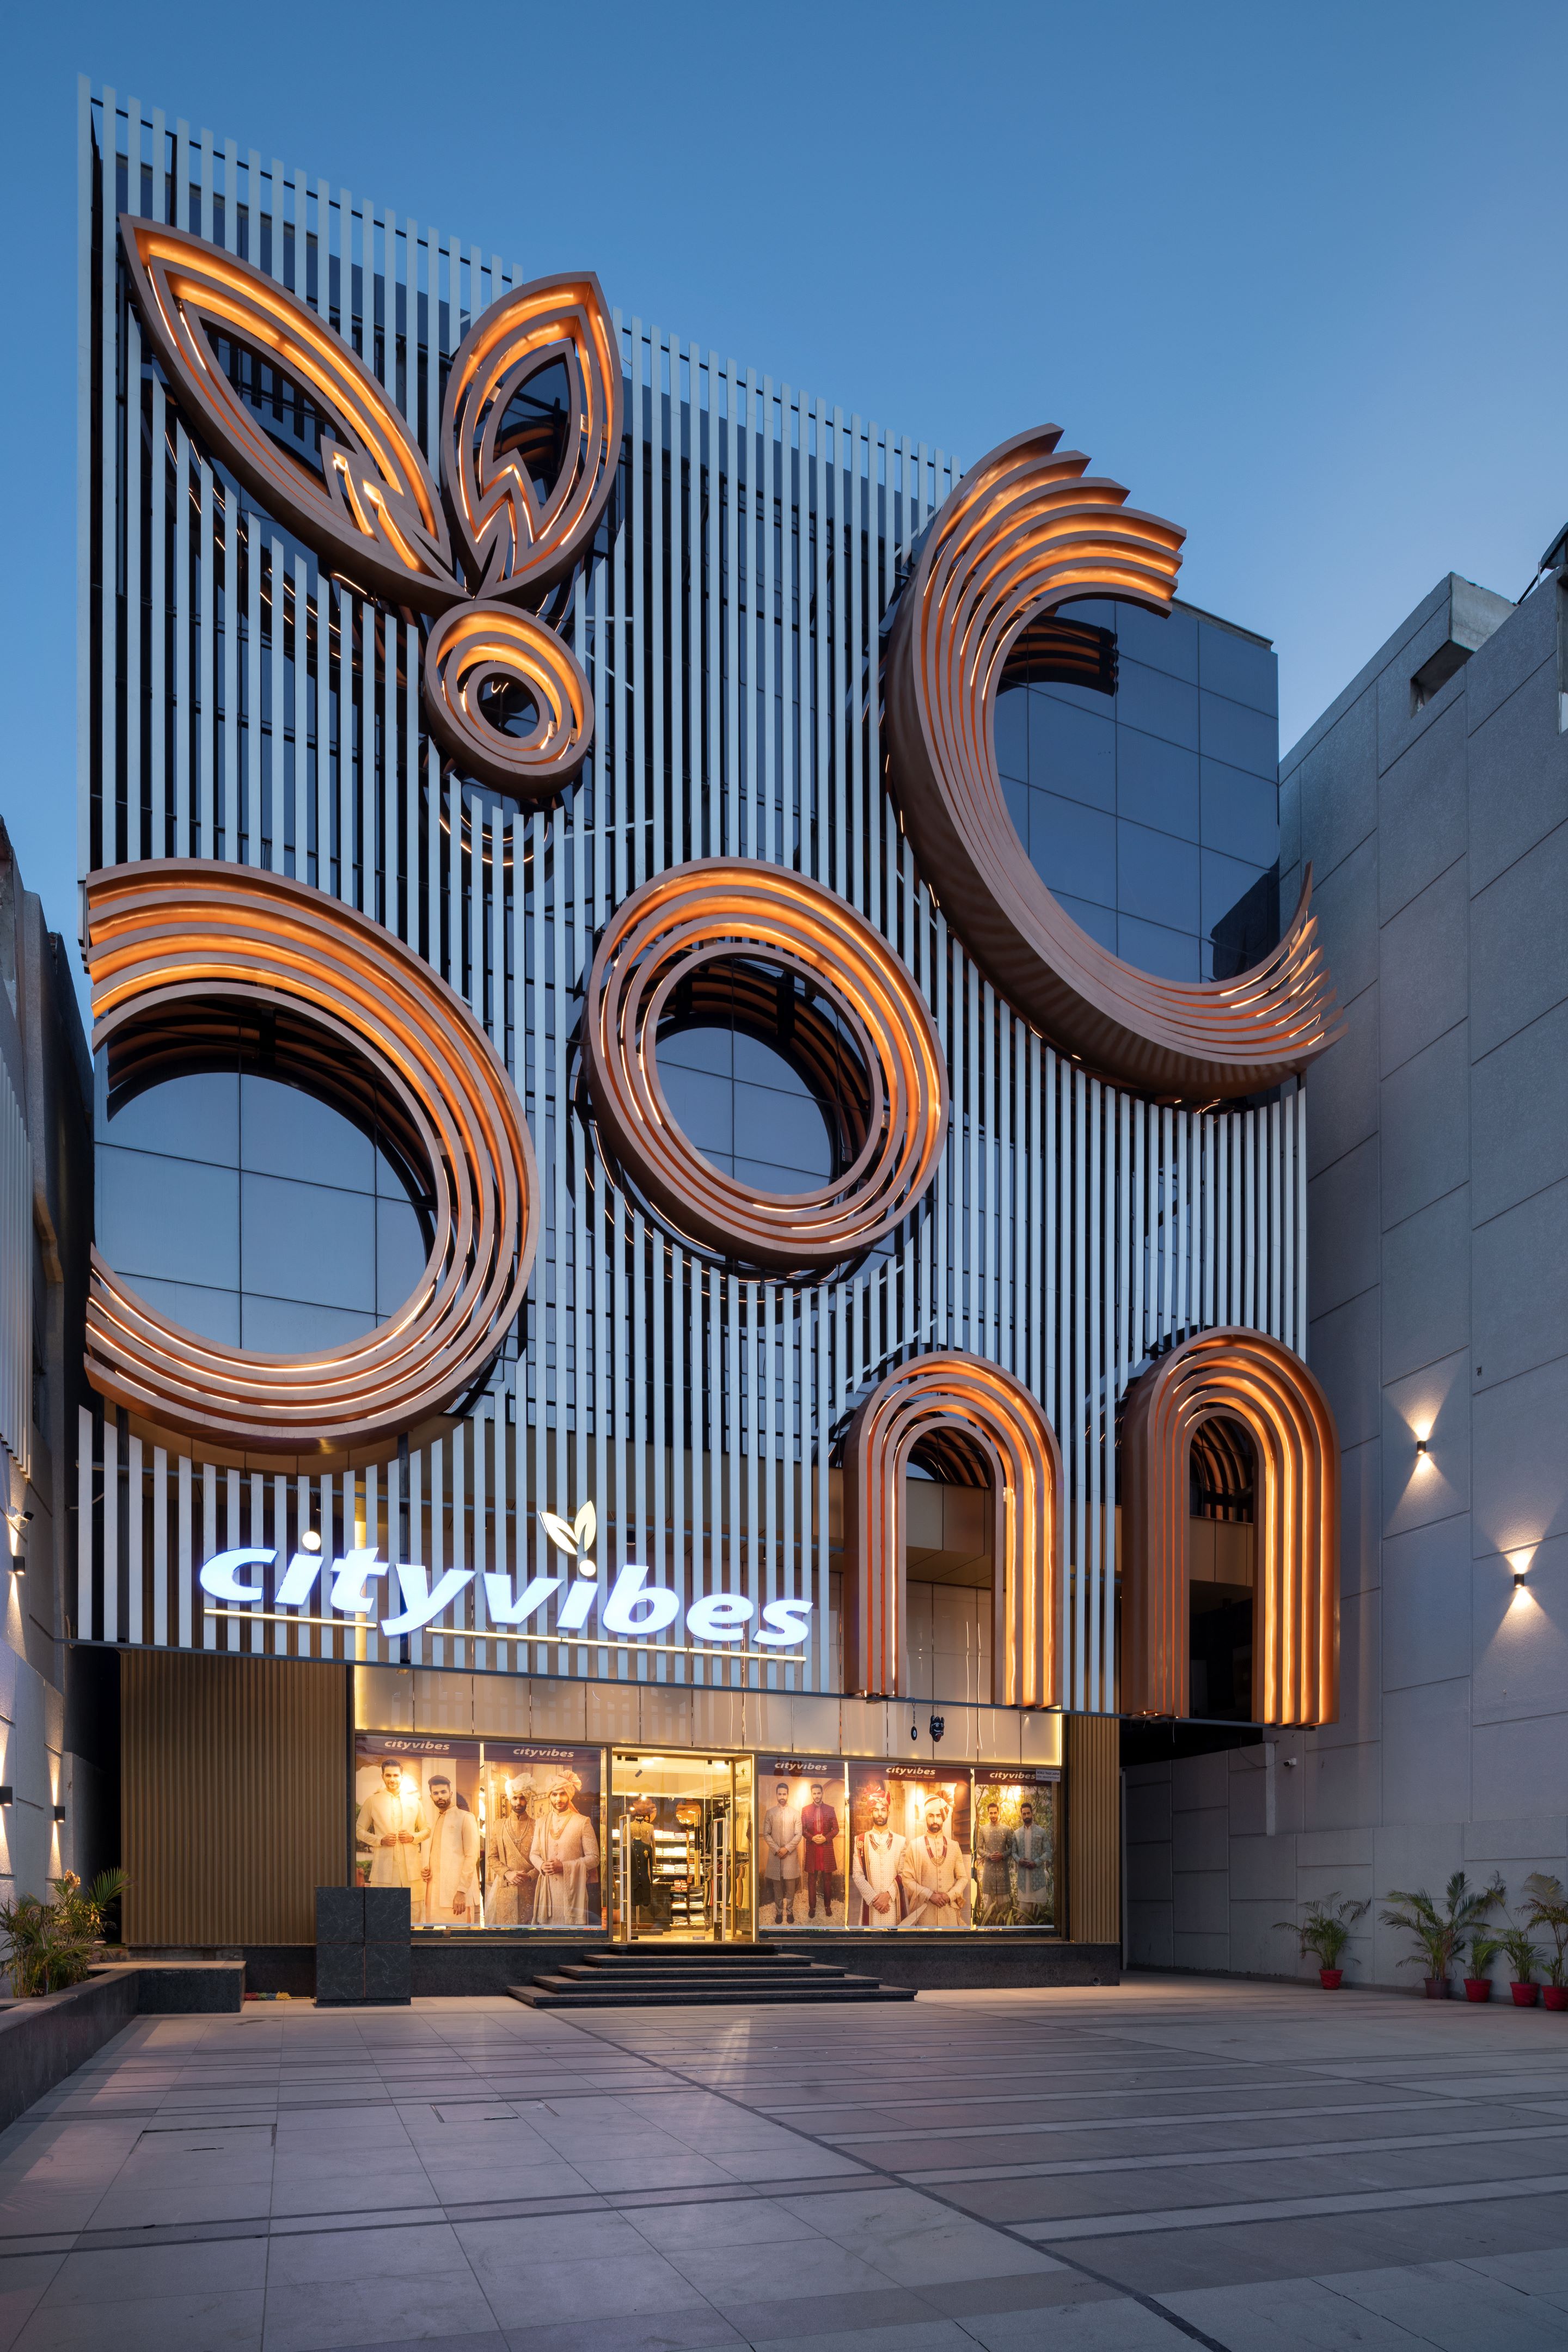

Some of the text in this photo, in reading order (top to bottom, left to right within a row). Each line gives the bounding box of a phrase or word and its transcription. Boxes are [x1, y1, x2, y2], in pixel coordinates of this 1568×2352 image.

[199, 1530, 813, 1646] cityvibes
[384, 1739, 450, 1750] cityvibes
[513, 1747, 574, 1757] cityvibes
[774, 1761, 828, 1771] cityvibes
[886, 1766, 936, 1775] cityvibes
[989, 1771, 1036, 1780] cityvibes
